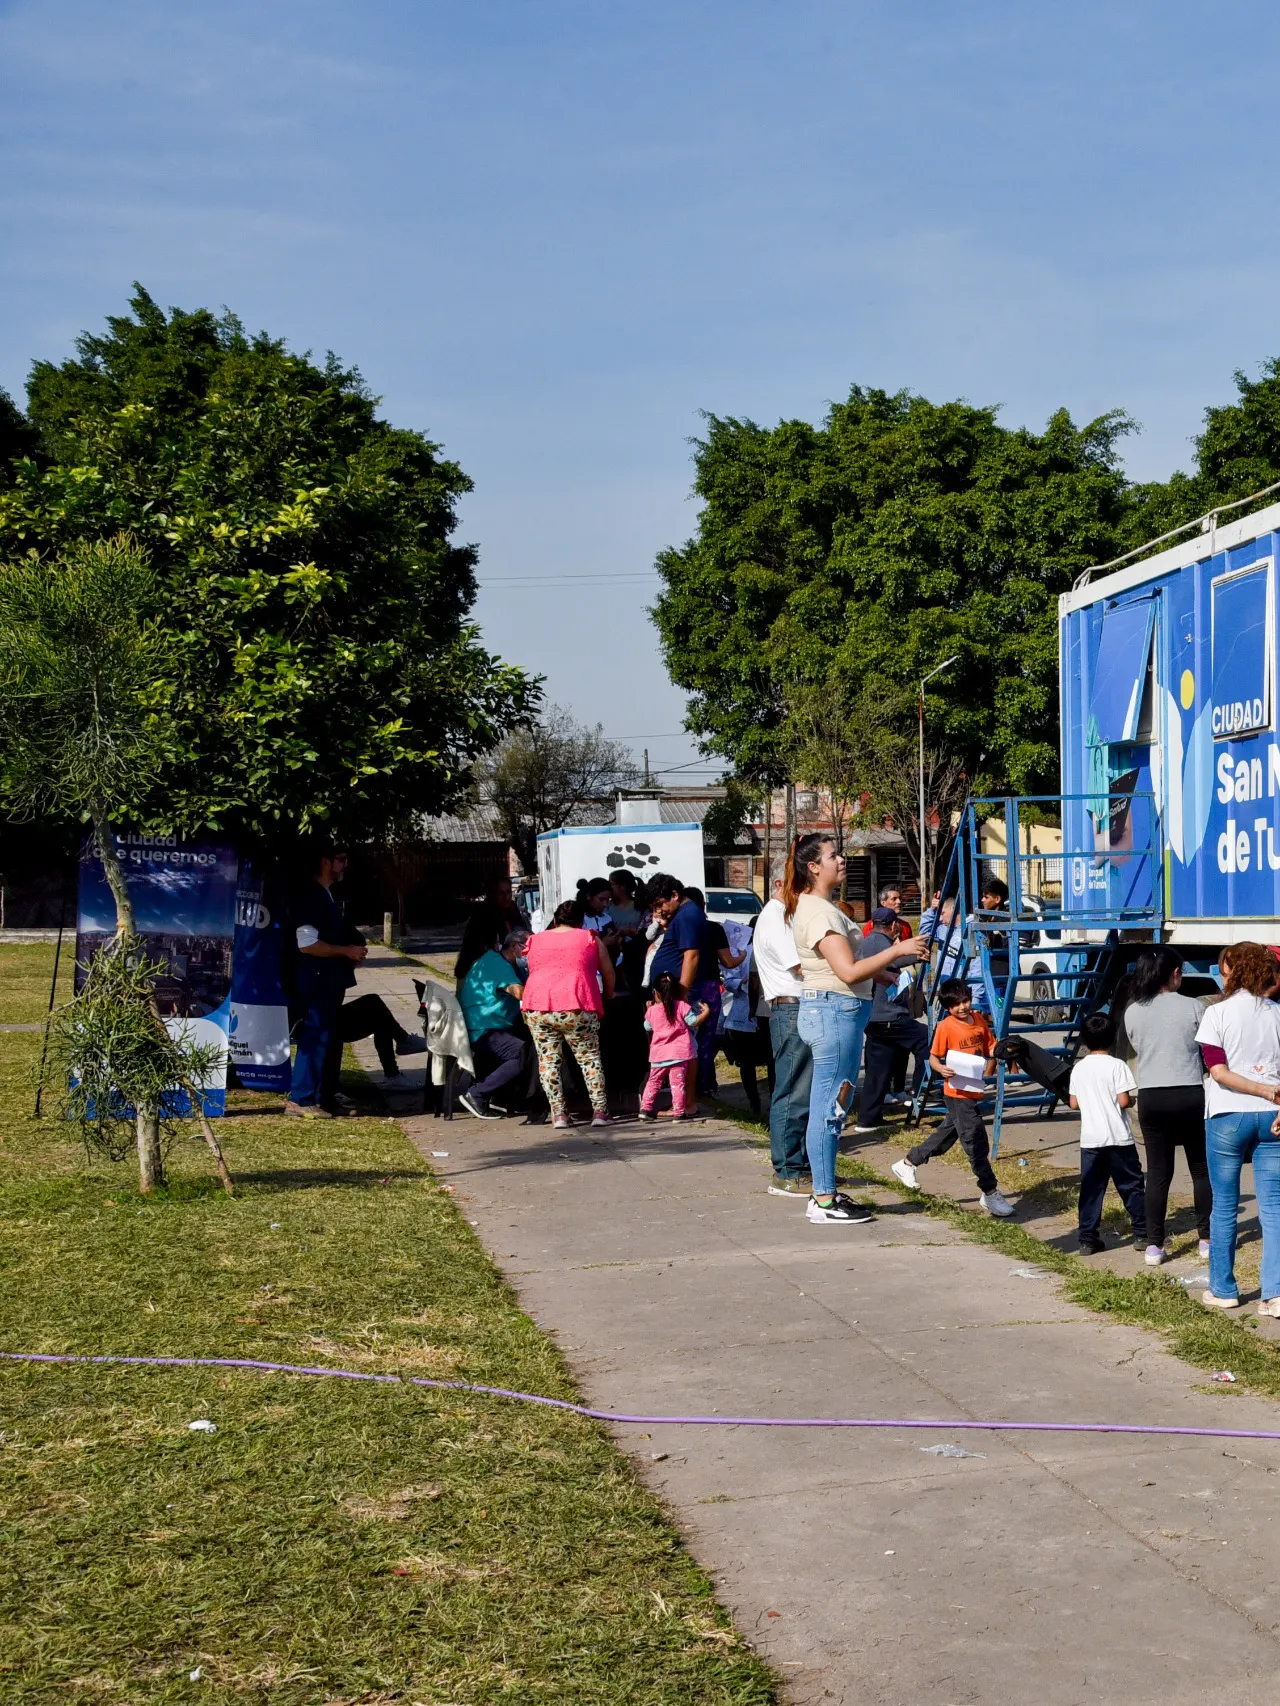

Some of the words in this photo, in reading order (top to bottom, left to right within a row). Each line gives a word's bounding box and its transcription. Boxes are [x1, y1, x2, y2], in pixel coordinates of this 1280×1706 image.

[1212, 698, 1263, 733] CIUDAD
[1217, 752, 1263, 805] San
[129, 848, 217, 865] queremos
[1217, 819, 1250, 874] de
